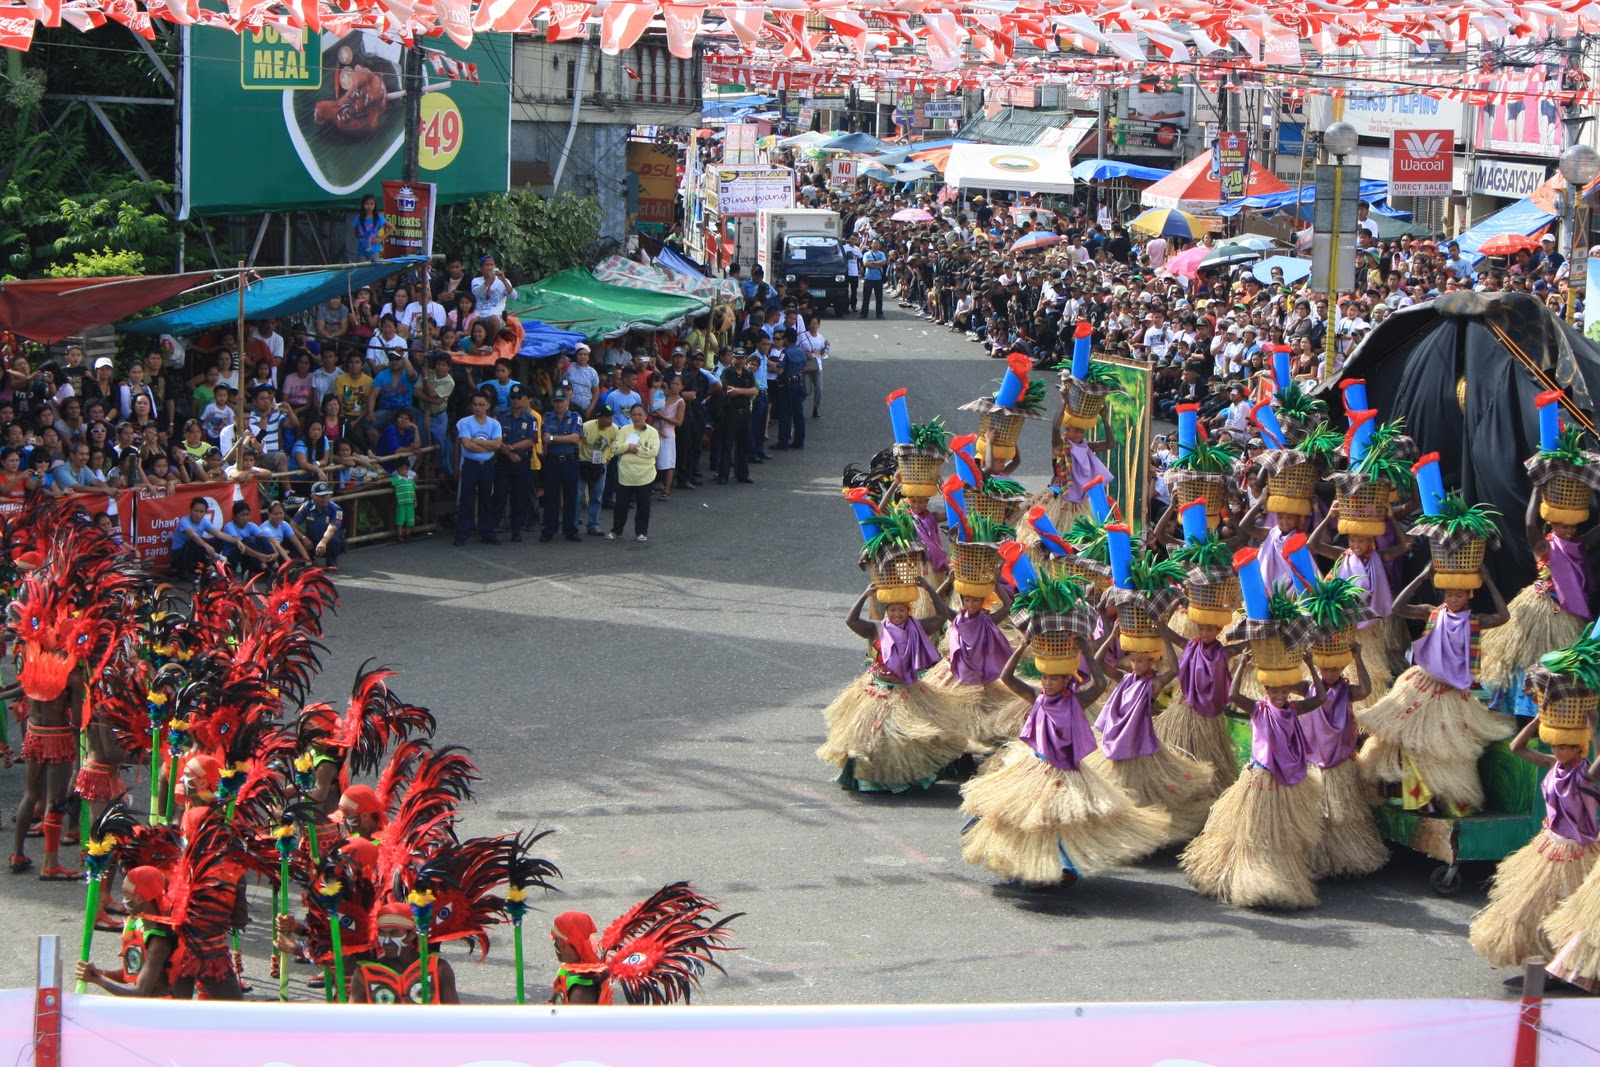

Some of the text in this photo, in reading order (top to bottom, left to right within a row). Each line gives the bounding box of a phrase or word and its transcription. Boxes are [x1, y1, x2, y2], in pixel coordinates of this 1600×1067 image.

[253, 50, 309, 78] MEAL
[838, 162, 851, 174] NO
[1401, 160, 1444, 171] Wacoal
[1475, 166, 1542, 193] MAGSAYSAY
[721, 193, 790, 206] Dinagyang
[386, 214, 421, 228] 50 texts
[151, 516, 180, 530] Uhaw?
[145, 547, 169, 557] sarap
